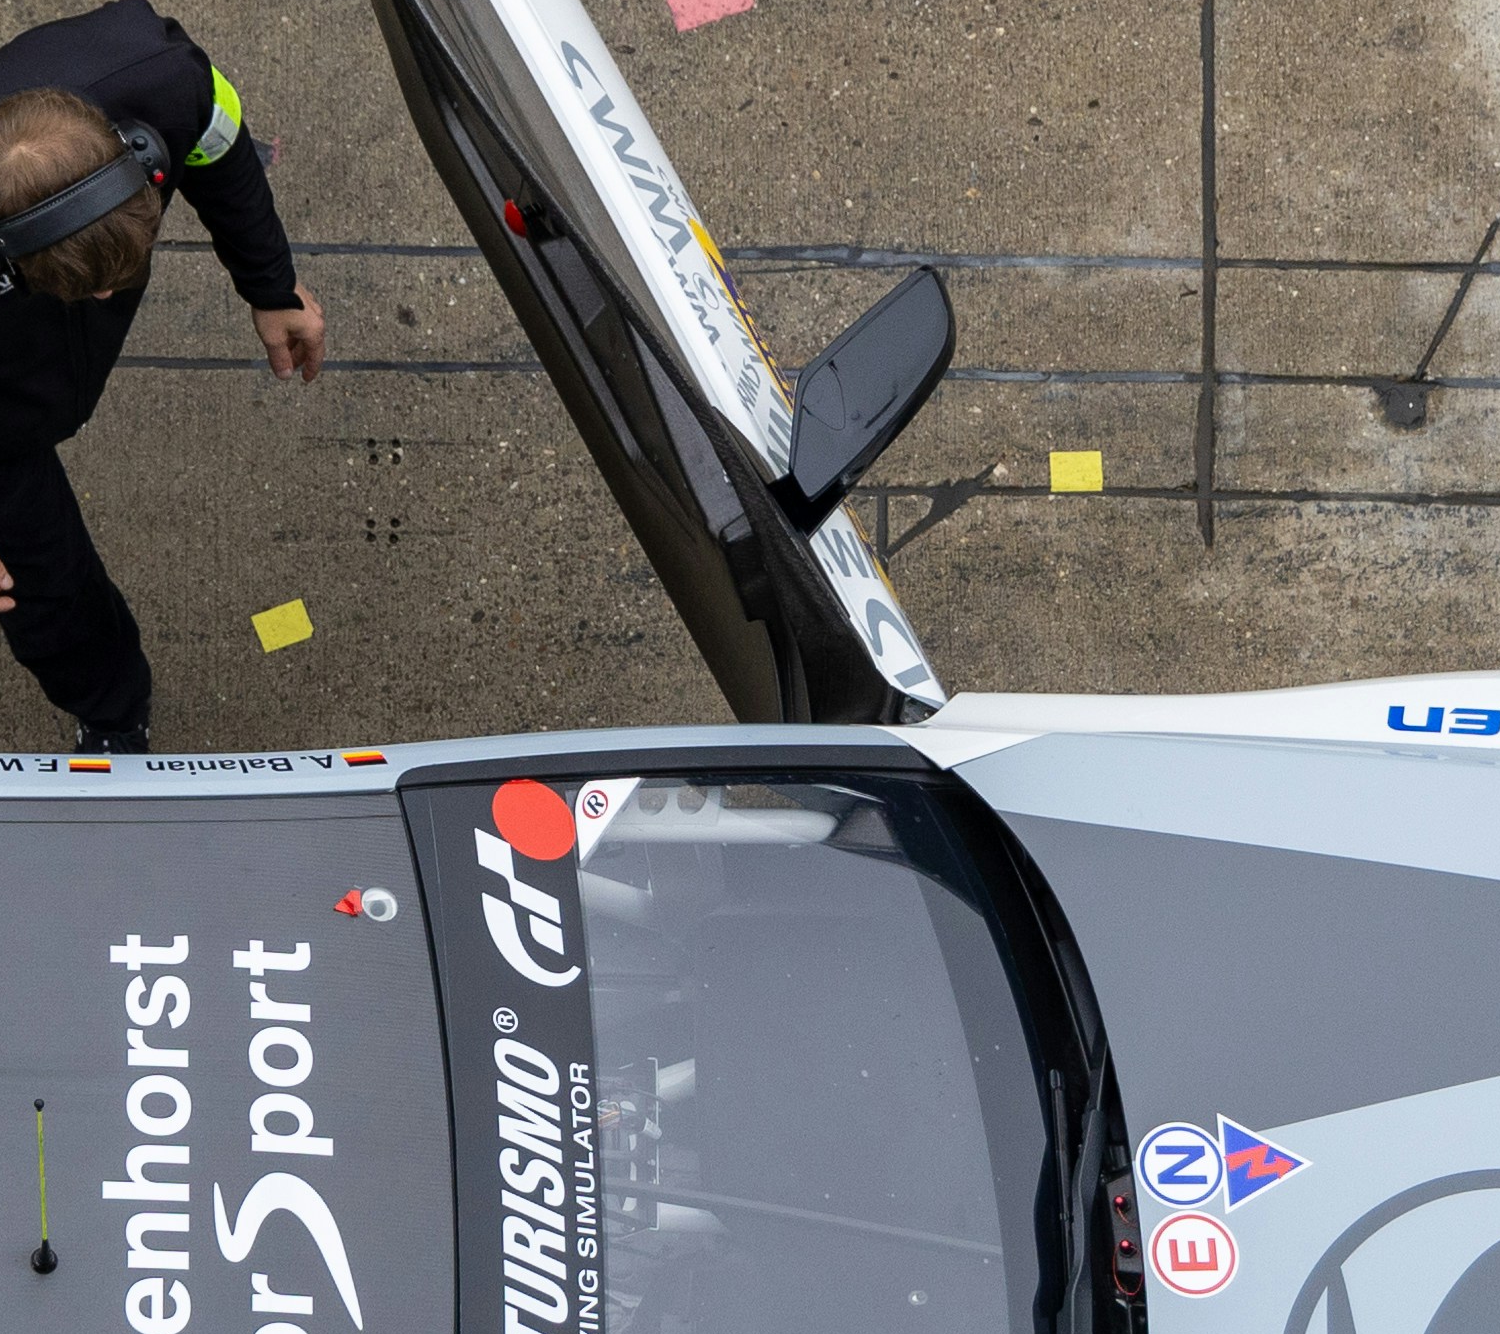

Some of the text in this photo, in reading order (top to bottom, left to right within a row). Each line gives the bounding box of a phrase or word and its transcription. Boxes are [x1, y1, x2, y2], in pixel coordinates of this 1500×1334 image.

[561, 40, 693, 255] WMS
[36, 757, 60, 774] F.
[145, 751, 335, 774] A. Balanian
[569, 1061, 598, 1259] SIMULATOR
[1168, 1238, 1219, 1272] E
